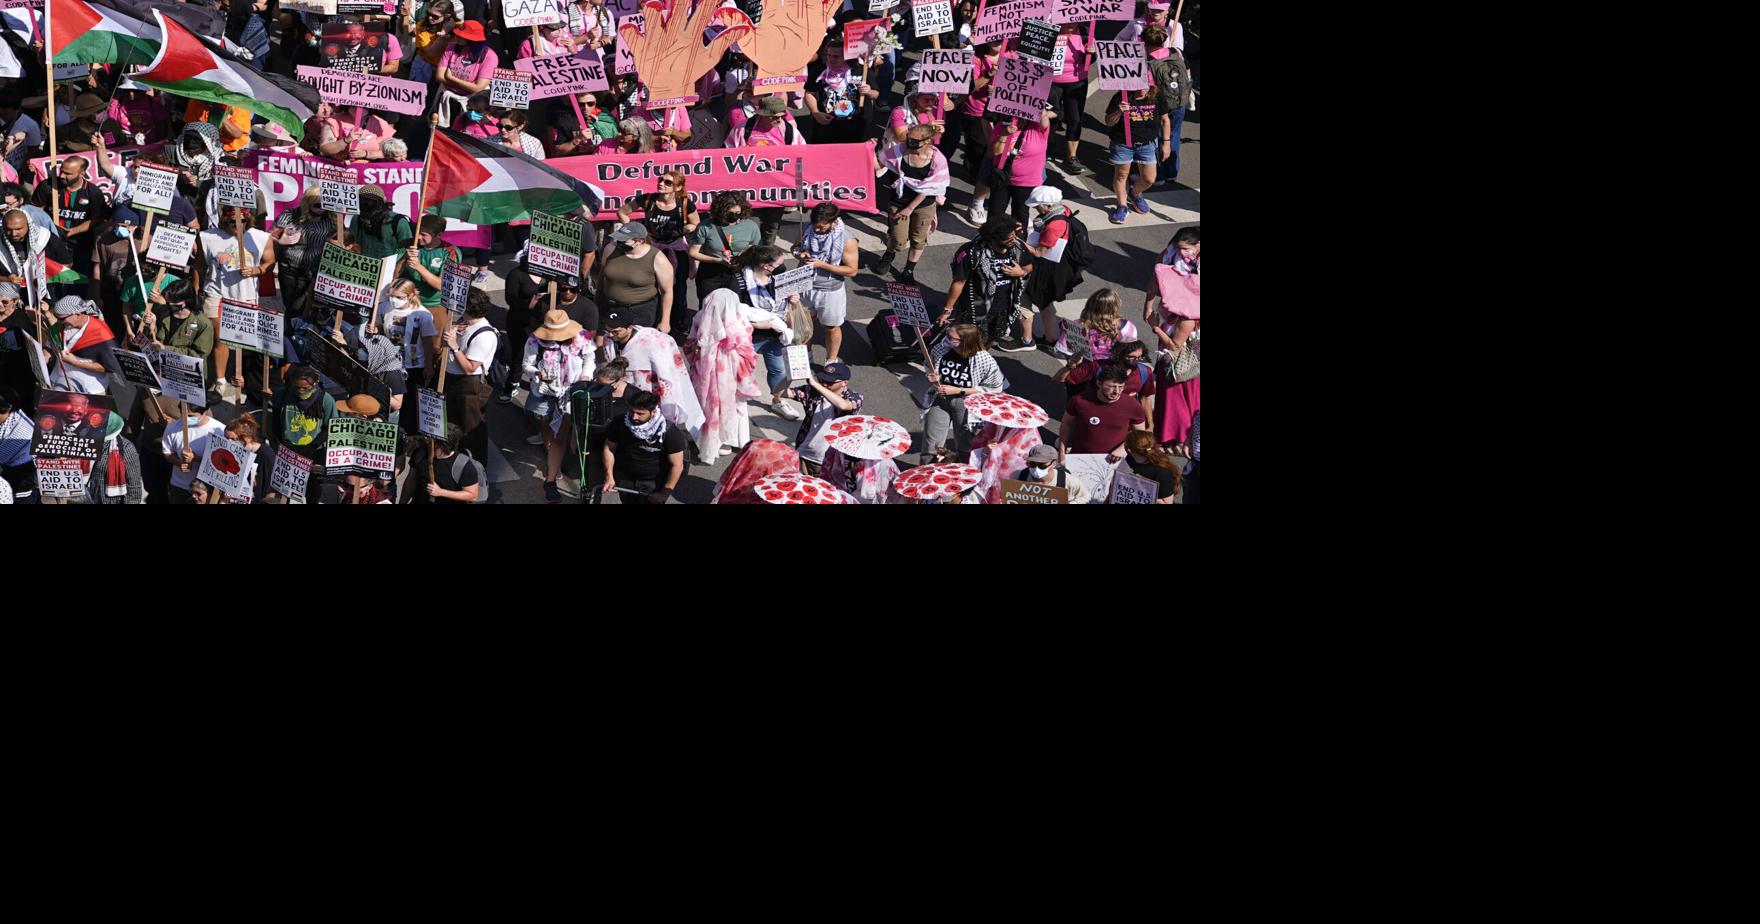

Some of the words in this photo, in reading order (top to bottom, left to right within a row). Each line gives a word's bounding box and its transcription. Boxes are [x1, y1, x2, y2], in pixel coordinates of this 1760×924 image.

[504, 0, 556, 18] GAZA
[916, 6, 932, 14] END
[984, 0, 1045, 17] FEMINISM
[1057, 8, 1080, 17] TO
[1081, 3, 1122, 14] WAR
[918, 13, 933, 21] AID
[1000, 10, 1024, 21] NOT
[1070, 13, 1107, 22] CODEPINK
[918, 17, 950, 28] ISRAEL!
[1098, 42, 1143, 59] PEACE
[532, 55, 580, 72] FREE
[923, 51, 972, 65] PEACE
[321, 69, 366, 80] DEMOCRATS
[922, 69, 969, 84] NOW
[1101, 62, 1142, 79] NOW
[531, 66, 604, 89] ALESTINE
[1005, 72, 1038, 86] OUT
[350, 81, 365, 96] BY
[544, 85, 587, 96] CODEPINK
[1007, 82, 1027, 92] OF
[493, 93, 527, 102] ISRAEL!
[994, 87, 1045, 110] POLITICS
[995, 105, 1034, 119] CODEPINK
[722, 153, 790, 175] War
[141, 170, 174, 181] IMMIGRANT
[320, 168, 340, 176] STAND
[217, 178, 234, 186] END
[218, 184, 234, 192] AID
[136, 185, 152, 194] FOR
[155, 189, 172, 199] ALL!
[219, 191, 253, 201] ISRAEL!
[323, 189, 340, 197] AID
[323, 196, 357, 207] ISRAEL!
[535, 212, 549, 221] FROM
[532, 217, 581, 241] CHICAGO
[326, 244, 341, 255] FROM
[531, 234, 580, 256] PALESTINE
[323, 249, 379, 274] CHICAGO
[530, 246, 579, 266] OCCUPATION
[530, 254, 539, 262] IS
[551, 260, 578, 273] CRIME!
[320, 264, 375, 288] PALESTINE
[443, 272, 455, 283] END
[317, 275, 373, 297] OCCUPATION
[443, 281, 453, 291] AID
[457, 286, 467, 295] TO
[316, 283, 325, 292] IS
[329, 288, 335, 296] A
[339, 290, 372, 305] CRIME!
[441, 289, 466, 304] ISRAEL!
[891, 295, 907, 303] END
[222, 306, 255, 318] IMMIGRANT
[894, 302, 909, 310] AID
[912, 305, 924, 313] TO
[222, 312, 241, 321] RIGHTS
[257, 312, 275, 322] STOP
[896, 309, 927, 320] ISRAEL!
[221, 322, 236, 331] FOR
[239, 326, 255, 334] ALL!
[258, 319, 278, 331] OLICE
[257, 326, 280, 338] RIMES!
[941, 367, 969, 381] OUR
[332, 417, 351, 425] FROM
[329, 424, 397, 440] CHICAGO
[42, 434, 95, 444] DEMOCRATS
[35, 447, 98, 458] PALESTINIANS
[38, 443, 82, 452] GENOCIDE
[328, 440, 394, 453] PALESTINE
[328, 450, 393, 463] OCCUPATION
[277, 458, 290, 471] END
[293, 468, 306, 479] U.S
[328, 457, 340, 465] IS
[355, 459, 392, 470] CRIME!
[275, 466, 289, 479] AID
[293, 475, 304, 486] TO
[273, 473, 304, 494] ISRAEL!
[1118, 485, 1135, 494] END
[1019, 483, 1052, 498] NOT
[1005, 491, 1058, 504] ANOTHER
[1117, 491, 1134, 500] AID
[1139, 496, 1152, 504] TO
